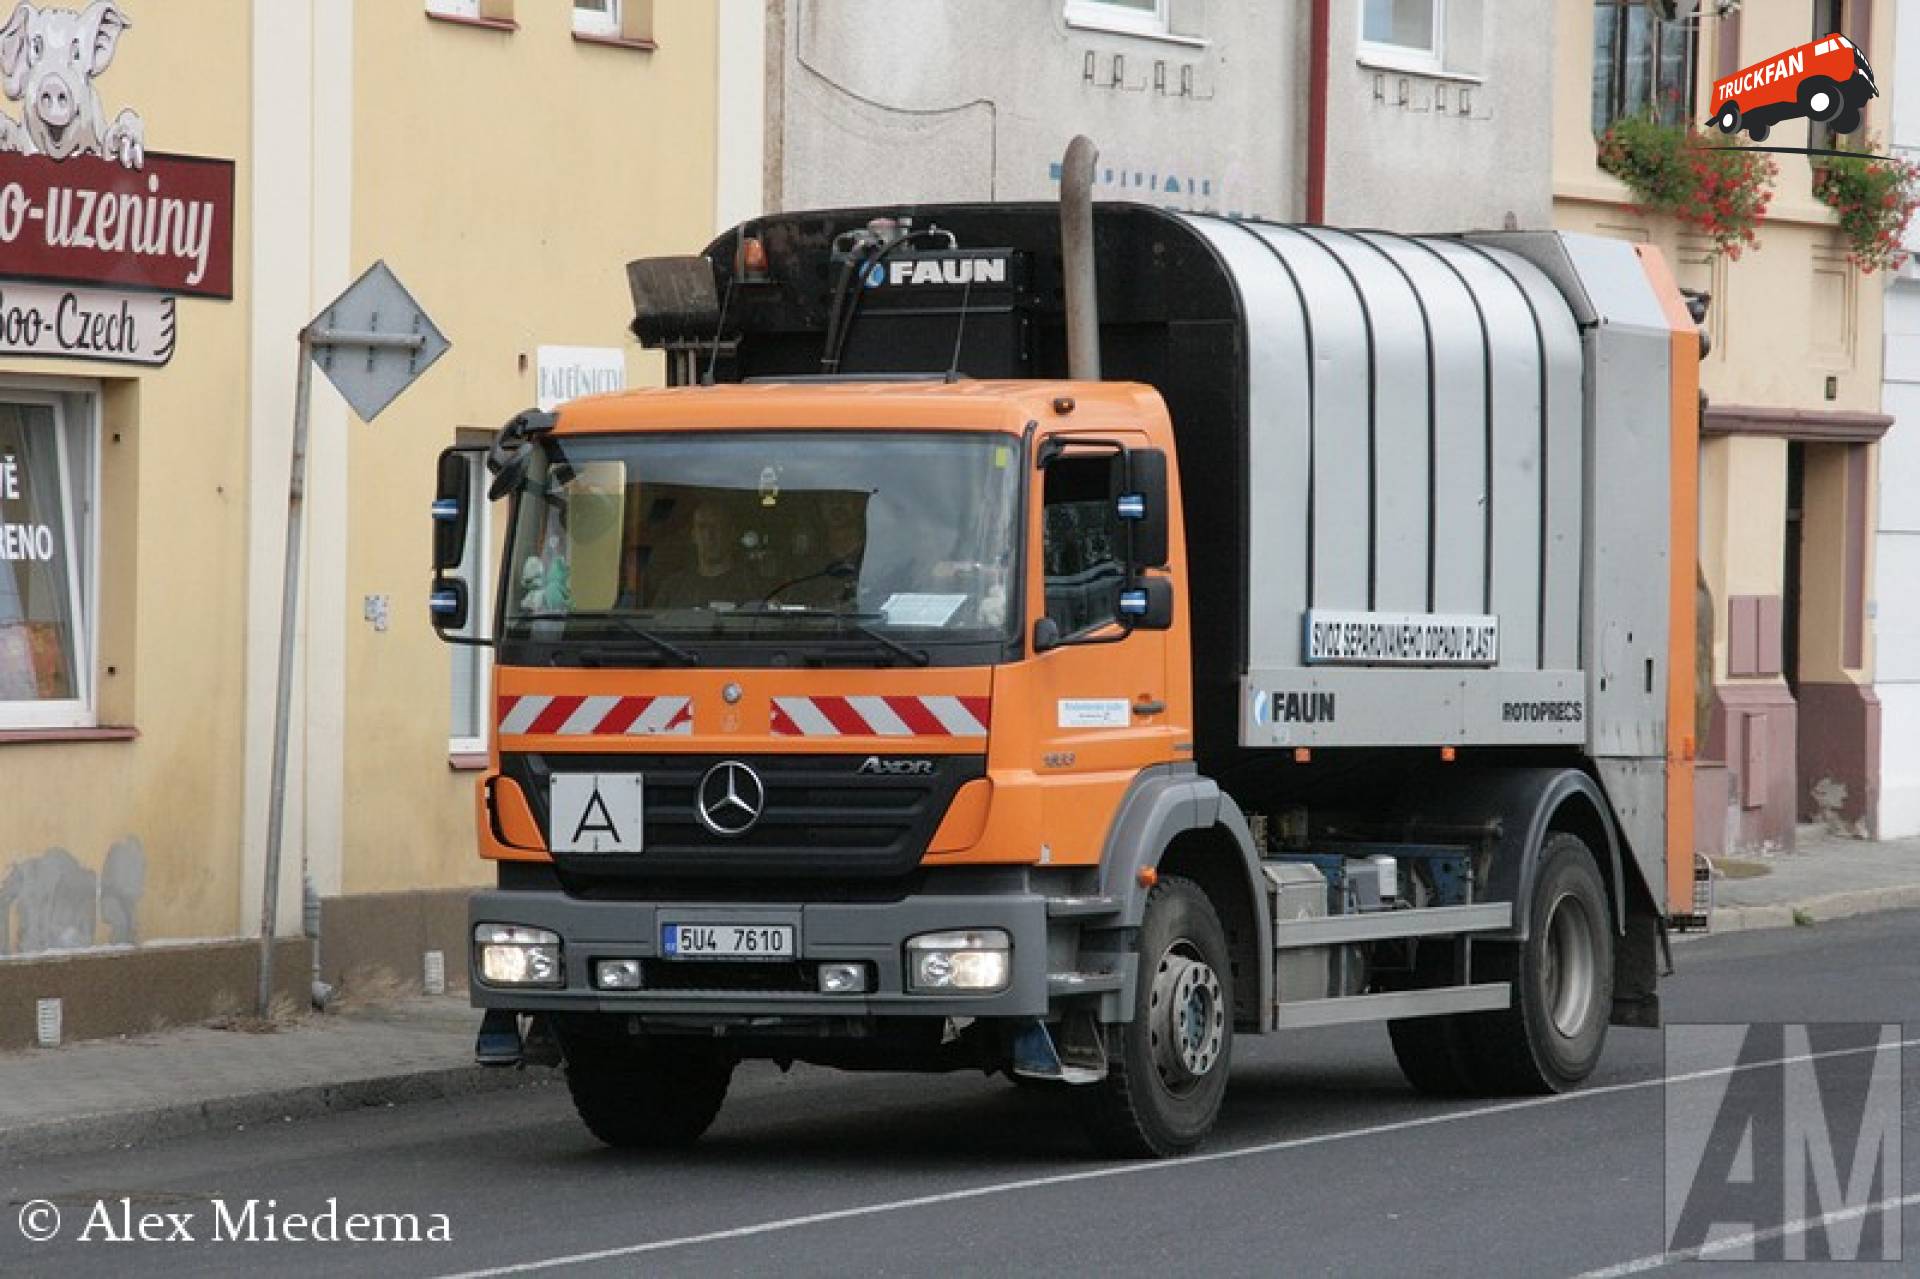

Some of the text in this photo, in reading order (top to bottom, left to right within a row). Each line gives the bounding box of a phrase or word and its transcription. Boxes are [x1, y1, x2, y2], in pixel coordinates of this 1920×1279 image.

[889, 258, 1006, 284] FAUN
[0, 290, 138, 352] oo-Czech
[1271, 692, 1335, 723] FAUN
[571, 787, 622, 843] A
[681, 928, 784, 951] 5U4 7610
